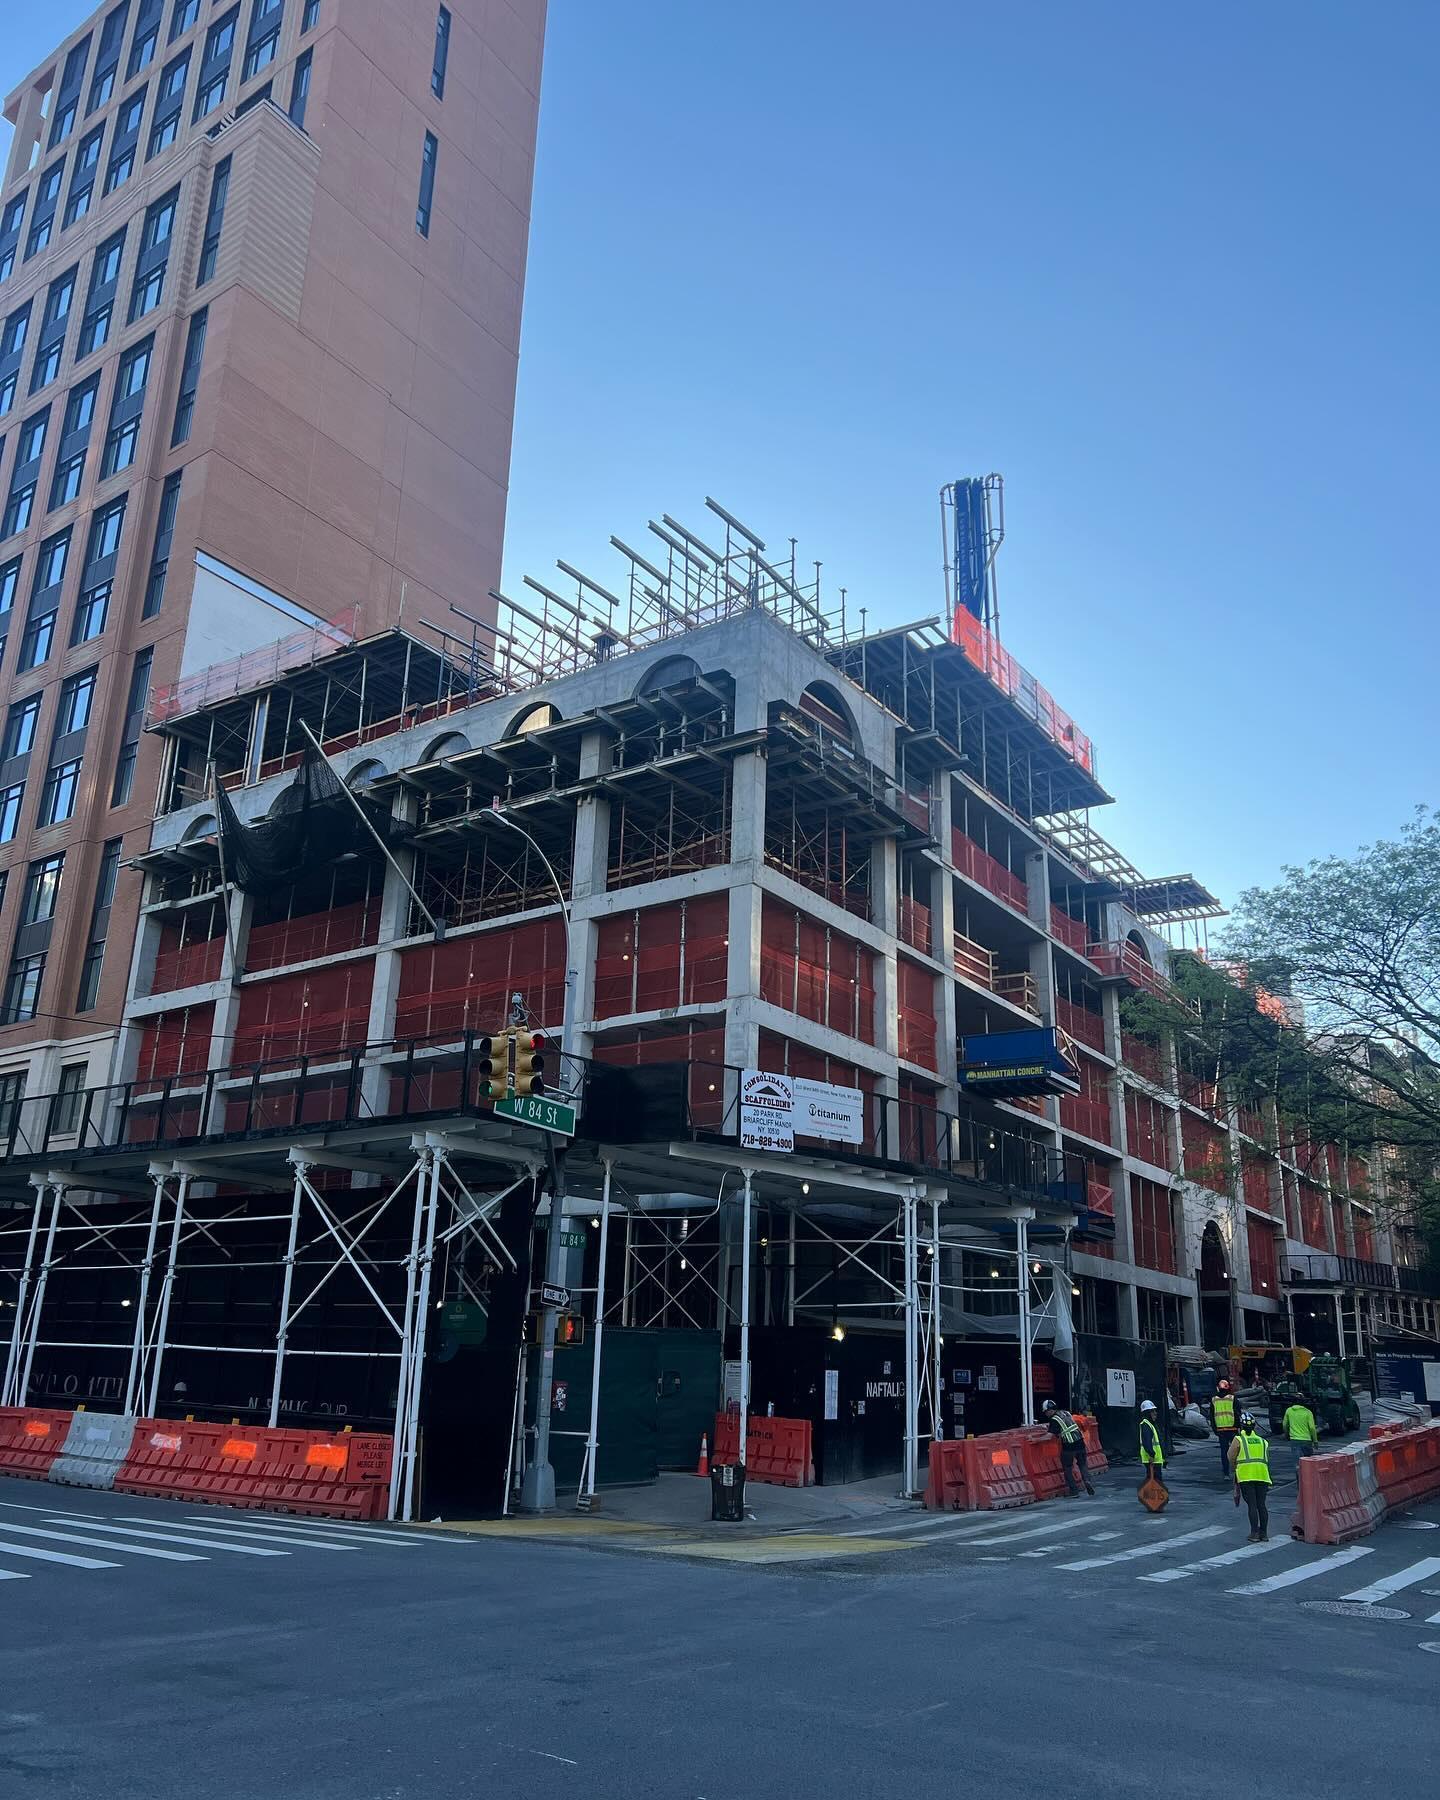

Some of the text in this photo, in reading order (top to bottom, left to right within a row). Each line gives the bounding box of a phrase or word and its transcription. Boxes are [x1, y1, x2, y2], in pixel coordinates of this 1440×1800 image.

[976, 1068, 1016, 1079] MANHATTAN
[744, 1074, 791, 1099] CONSOLIDATED
[745, 1095, 791, 1109] SCAFFOLDING
[514, 1097, 558, 1125] W 84 St
[753, 1109, 760, 1117] 20
[761, 1110, 775, 1119] PARK
[817, 1107, 851, 1122] titanium
[744, 1116, 792, 1128] BRIARCLIFF MANOR
[561, 1233, 568, 1245] W
[569, 1234, 578, 1246] 84
[546, 1289, 555, 1299] ONE
[1113, 1371, 1129, 1382] GATE
[357, 1442, 392, 1451] LANE CLOSED
[363, 1451, 384, 1459] PLEASE
[357, 1460, 387, 1469] MERGE LEFT
